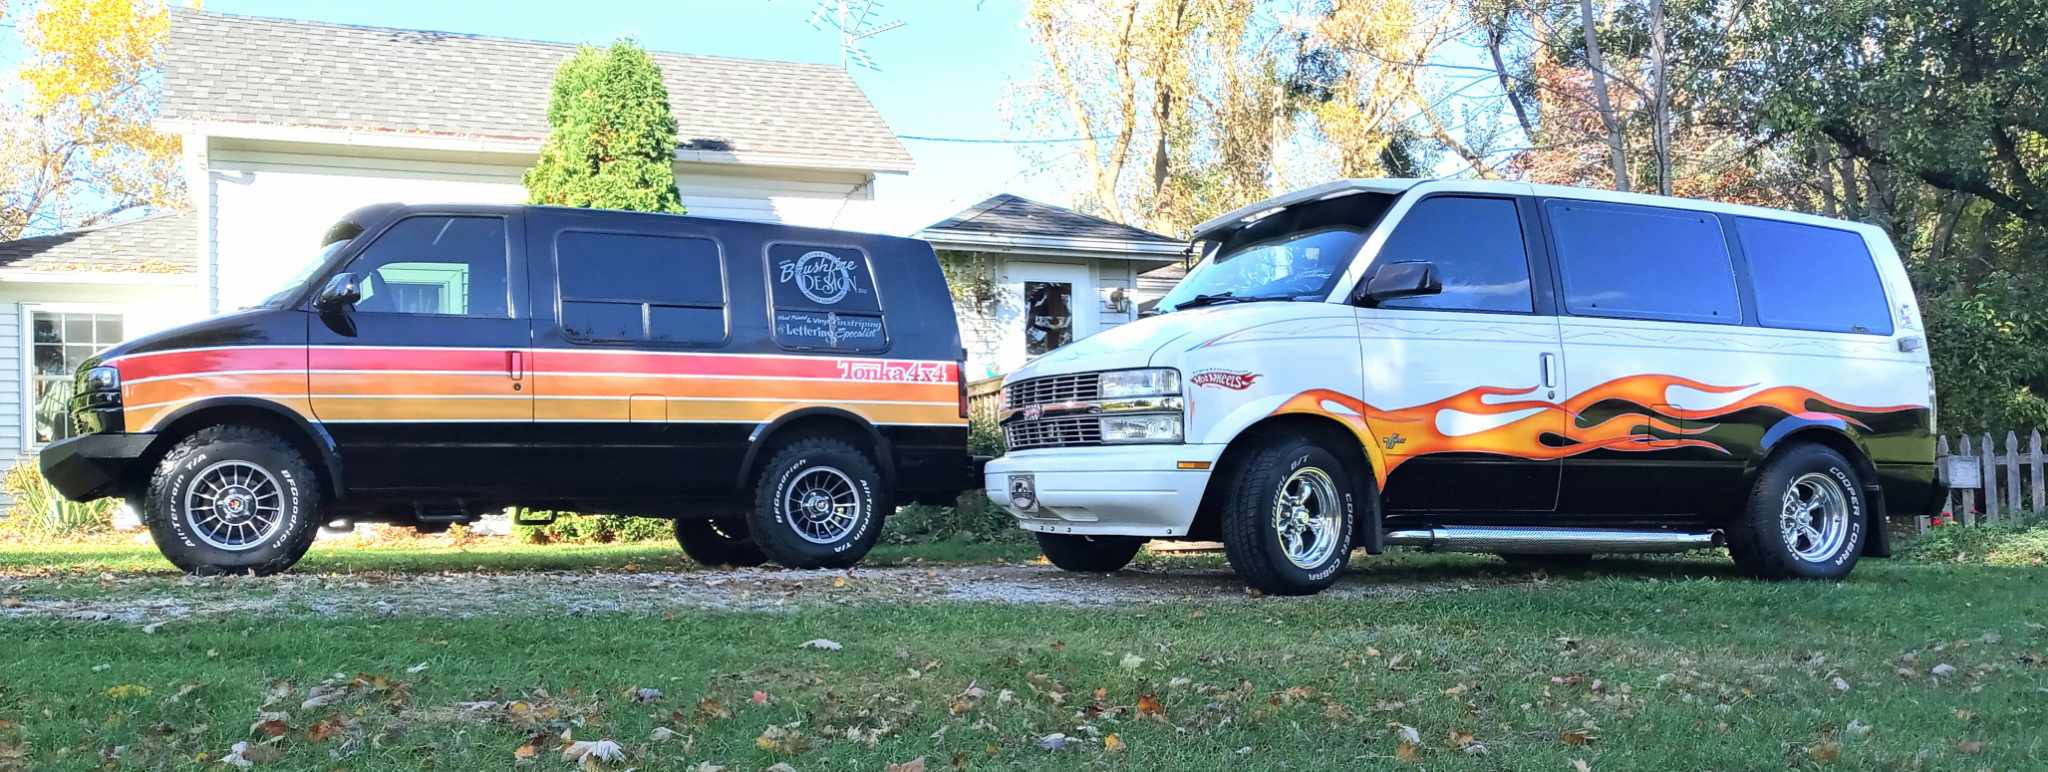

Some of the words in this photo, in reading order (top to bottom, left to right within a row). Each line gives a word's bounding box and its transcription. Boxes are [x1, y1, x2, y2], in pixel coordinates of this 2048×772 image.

[778, 257, 857, 283] Brushfire
[802, 271, 857, 294] DESIGN
[837, 359, 905, 382] Tonka
[905, 361, 946, 382] 4x4
[185, 454, 208, 471] T/A
[773, 458, 807, 524] BFGoodrich
[1829, 466, 1861, 516] COOPER
[272, 469, 299, 549] BFGoodrich
[1340, 493, 1354, 555] COOPER
[834, 542, 853, 553] T/A
[1836, 522, 1860, 566] COBRA
[1308, 557, 1341, 581] COBRA
